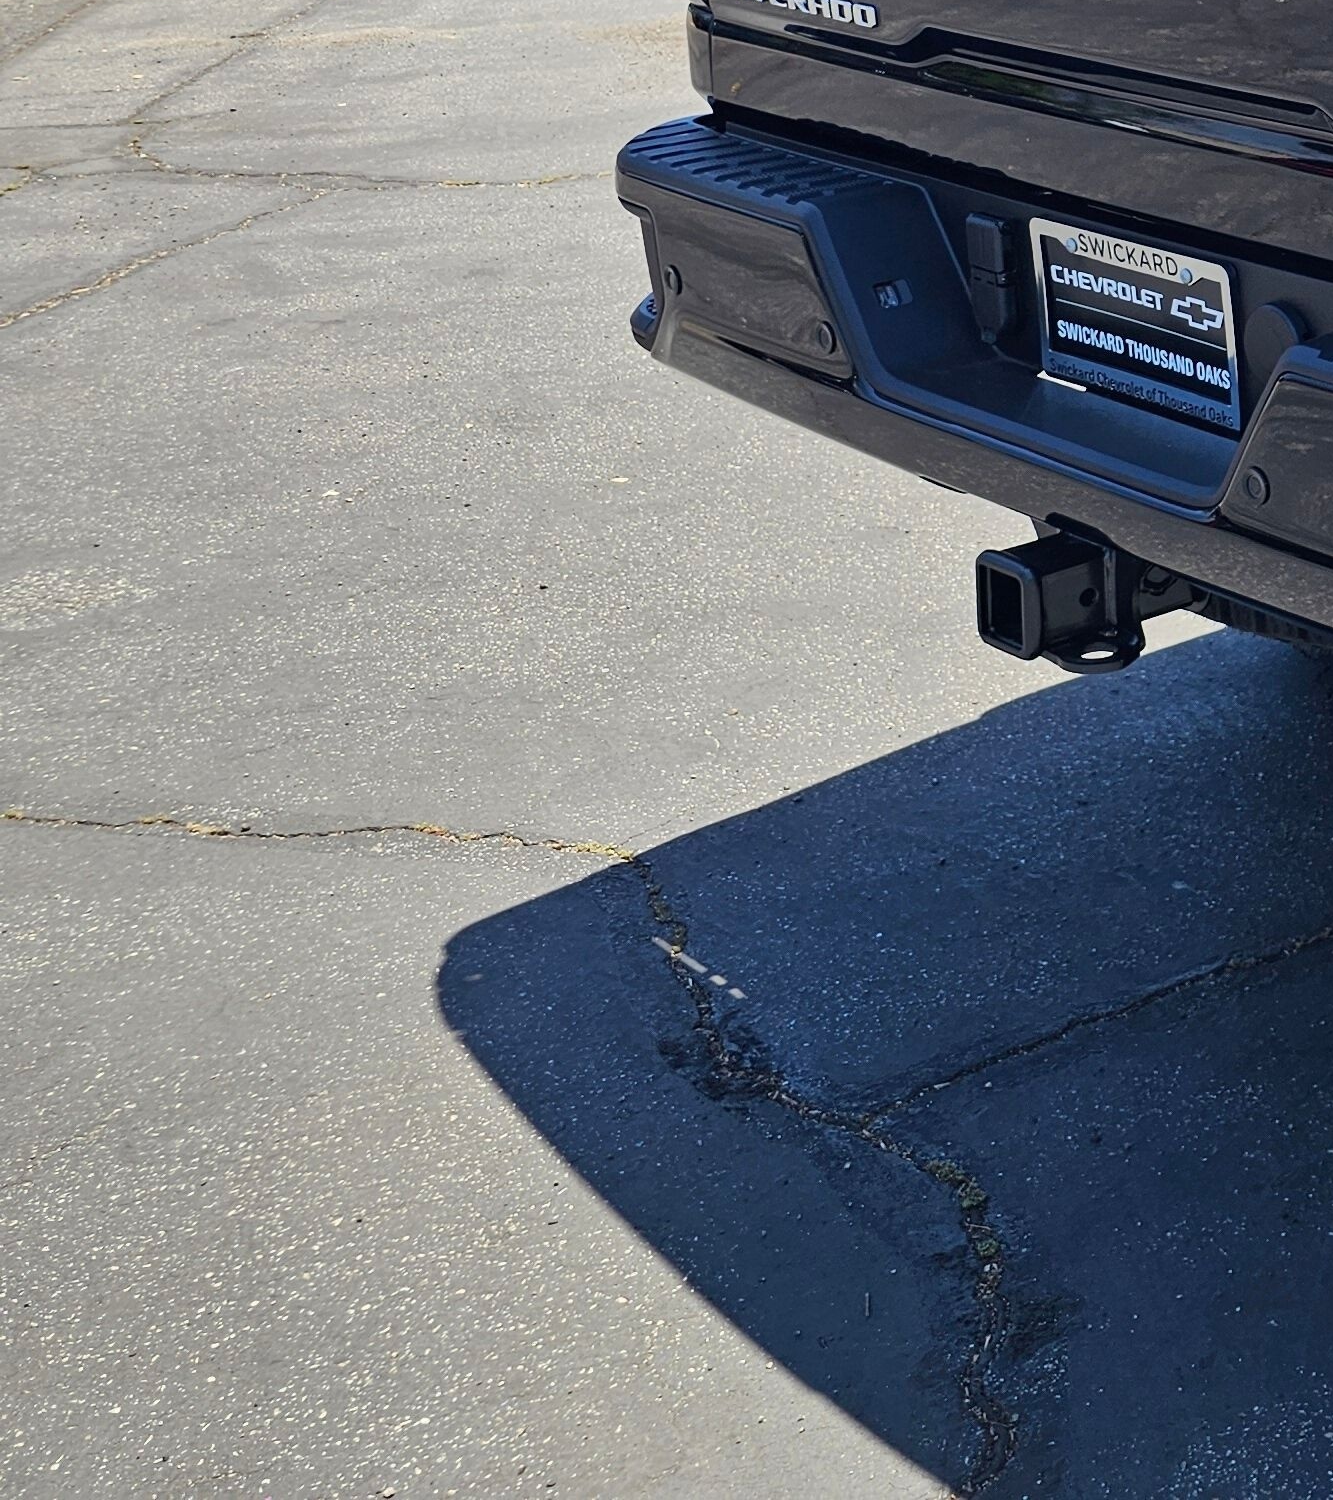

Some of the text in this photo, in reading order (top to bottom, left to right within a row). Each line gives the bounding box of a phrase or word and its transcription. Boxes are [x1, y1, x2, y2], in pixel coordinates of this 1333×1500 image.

[1078, 233, 1179, 277] SWICKARD
[1050, 264, 1163, 311] CHEVROLET
[1057, 319, 1232, 390] SWICKARD THOUSAND OAKS
[1050, 357, 1234, 428] Swickard Chevrolet of Thousand Oaks
